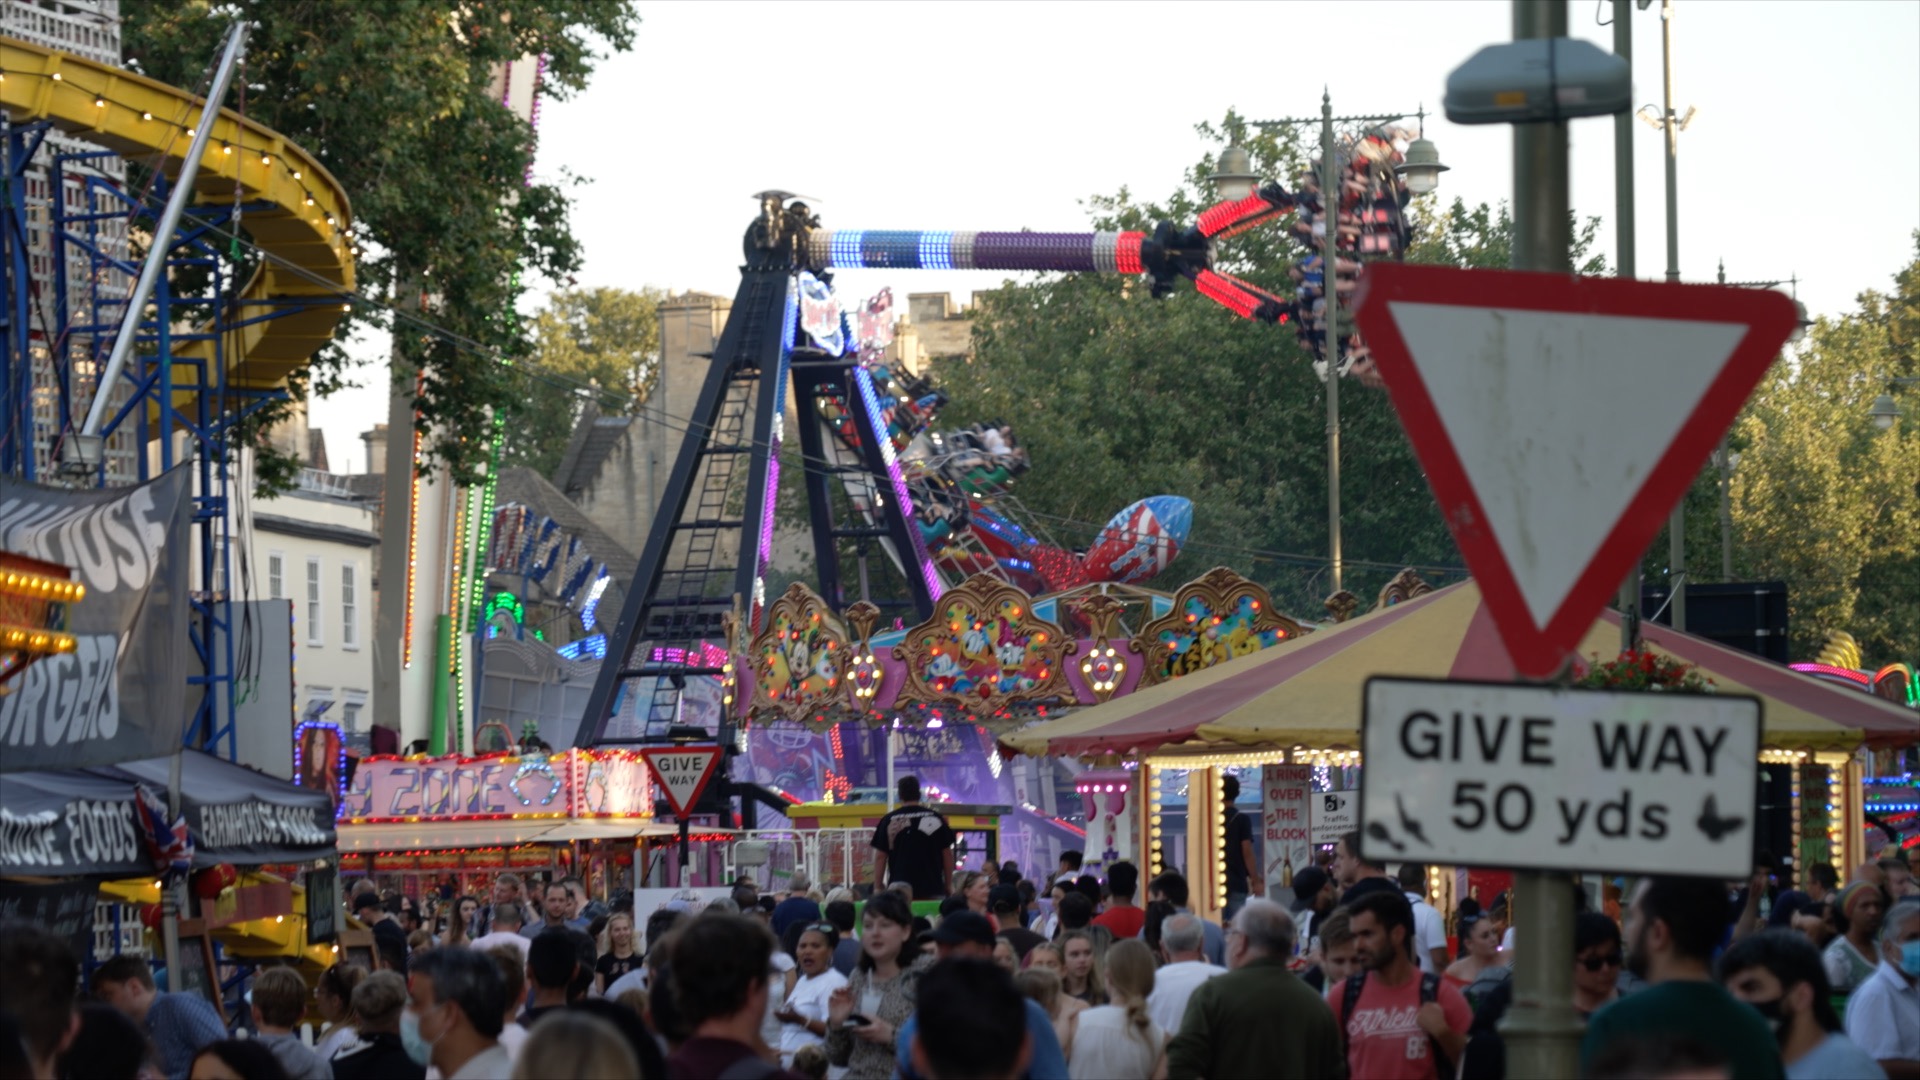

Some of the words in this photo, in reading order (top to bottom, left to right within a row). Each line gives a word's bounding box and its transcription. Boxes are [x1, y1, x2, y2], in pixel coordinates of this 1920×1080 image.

[1401, 709, 1554, 766] GIVE
[1594, 722, 1729, 776] WAY
[658, 756, 703, 772] GIVE
[668, 775, 697, 786] WAY
[1266, 768, 1273, 781] 1
[1276, 768, 1307, 781] RING
[1270, 788, 1303, 800] OVER
[1275, 808, 1298, 820] THE
[1322, 815, 1349, 823] Traffic
[1451, 781, 1535, 833] 50
[1557, 788, 1670, 846] yds
[200, 801, 280, 848] FARMHOUSE
[65, 799, 138, 865] FOODS
[1267, 828, 1307, 841] BLOCK
[1346, 1005, 1418, 1036] Athleti
